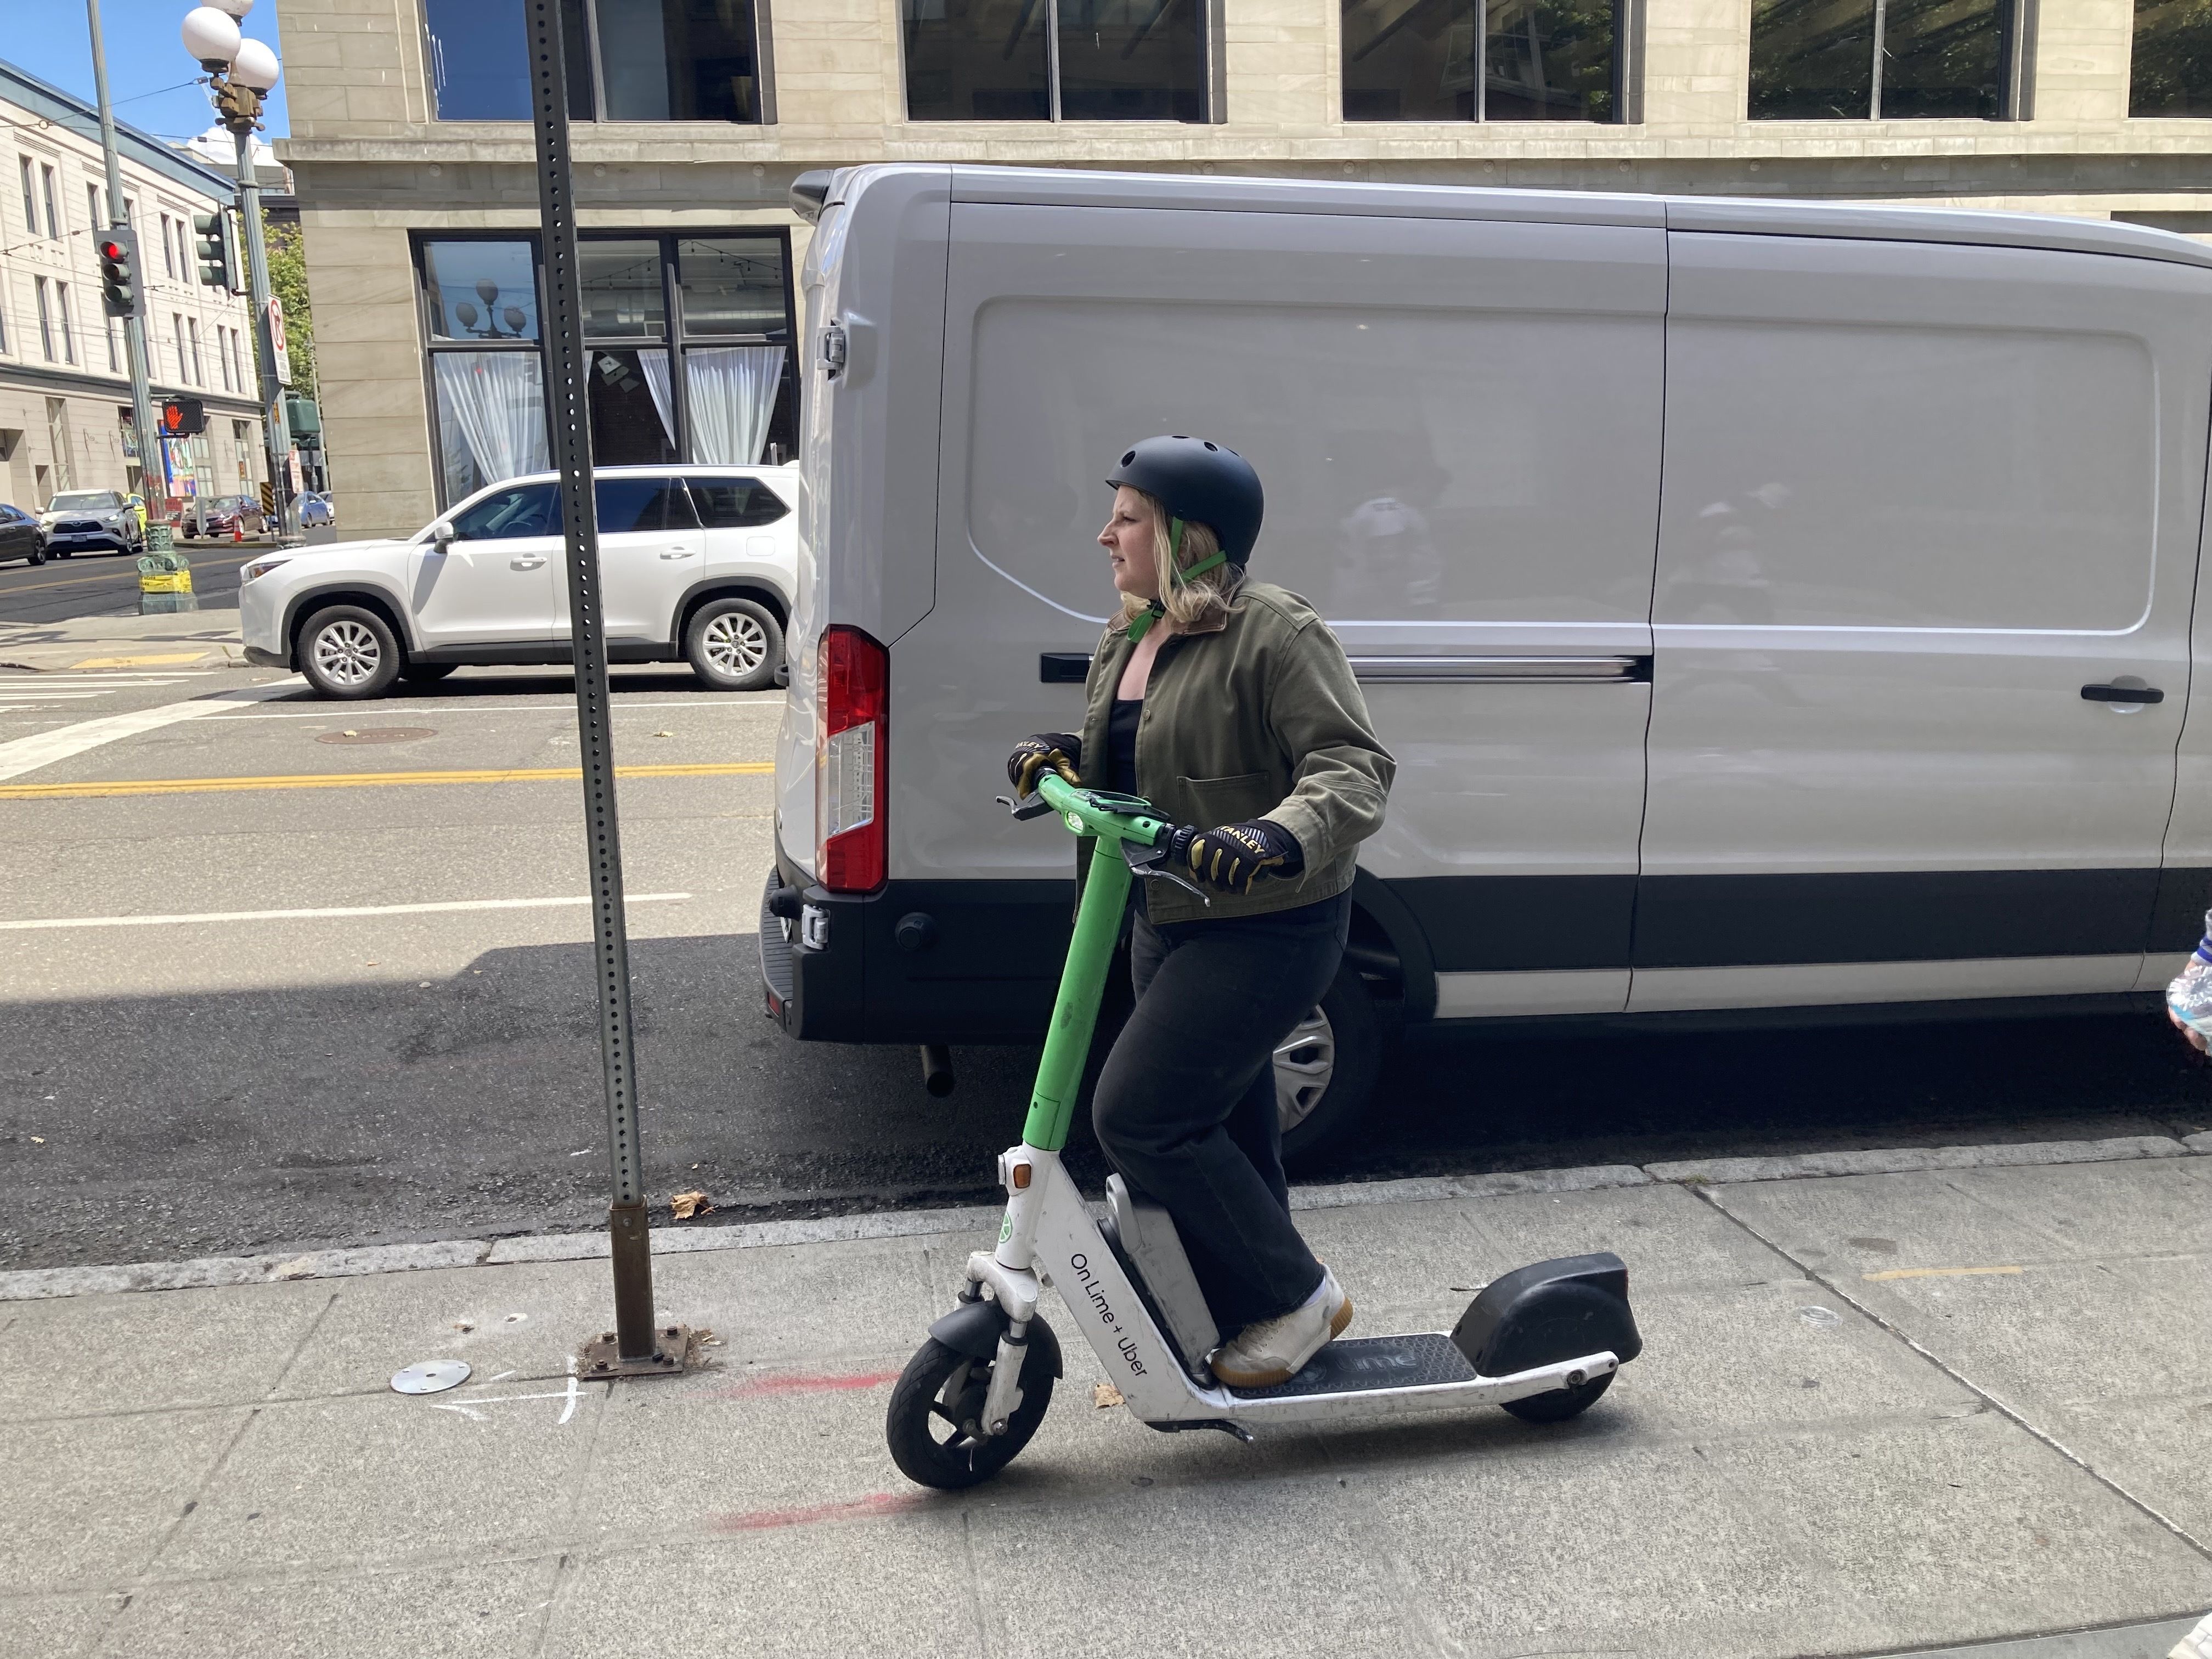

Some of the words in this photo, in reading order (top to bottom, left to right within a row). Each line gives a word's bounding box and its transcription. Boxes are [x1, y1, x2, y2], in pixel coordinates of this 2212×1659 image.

[1220, 825, 1265, 854] TANLEY
[1071, 1254, 1091, 1282] On
[1085, 1280, 1114, 1323] Lime
[1118, 1337, 1147, 1376] Uber
